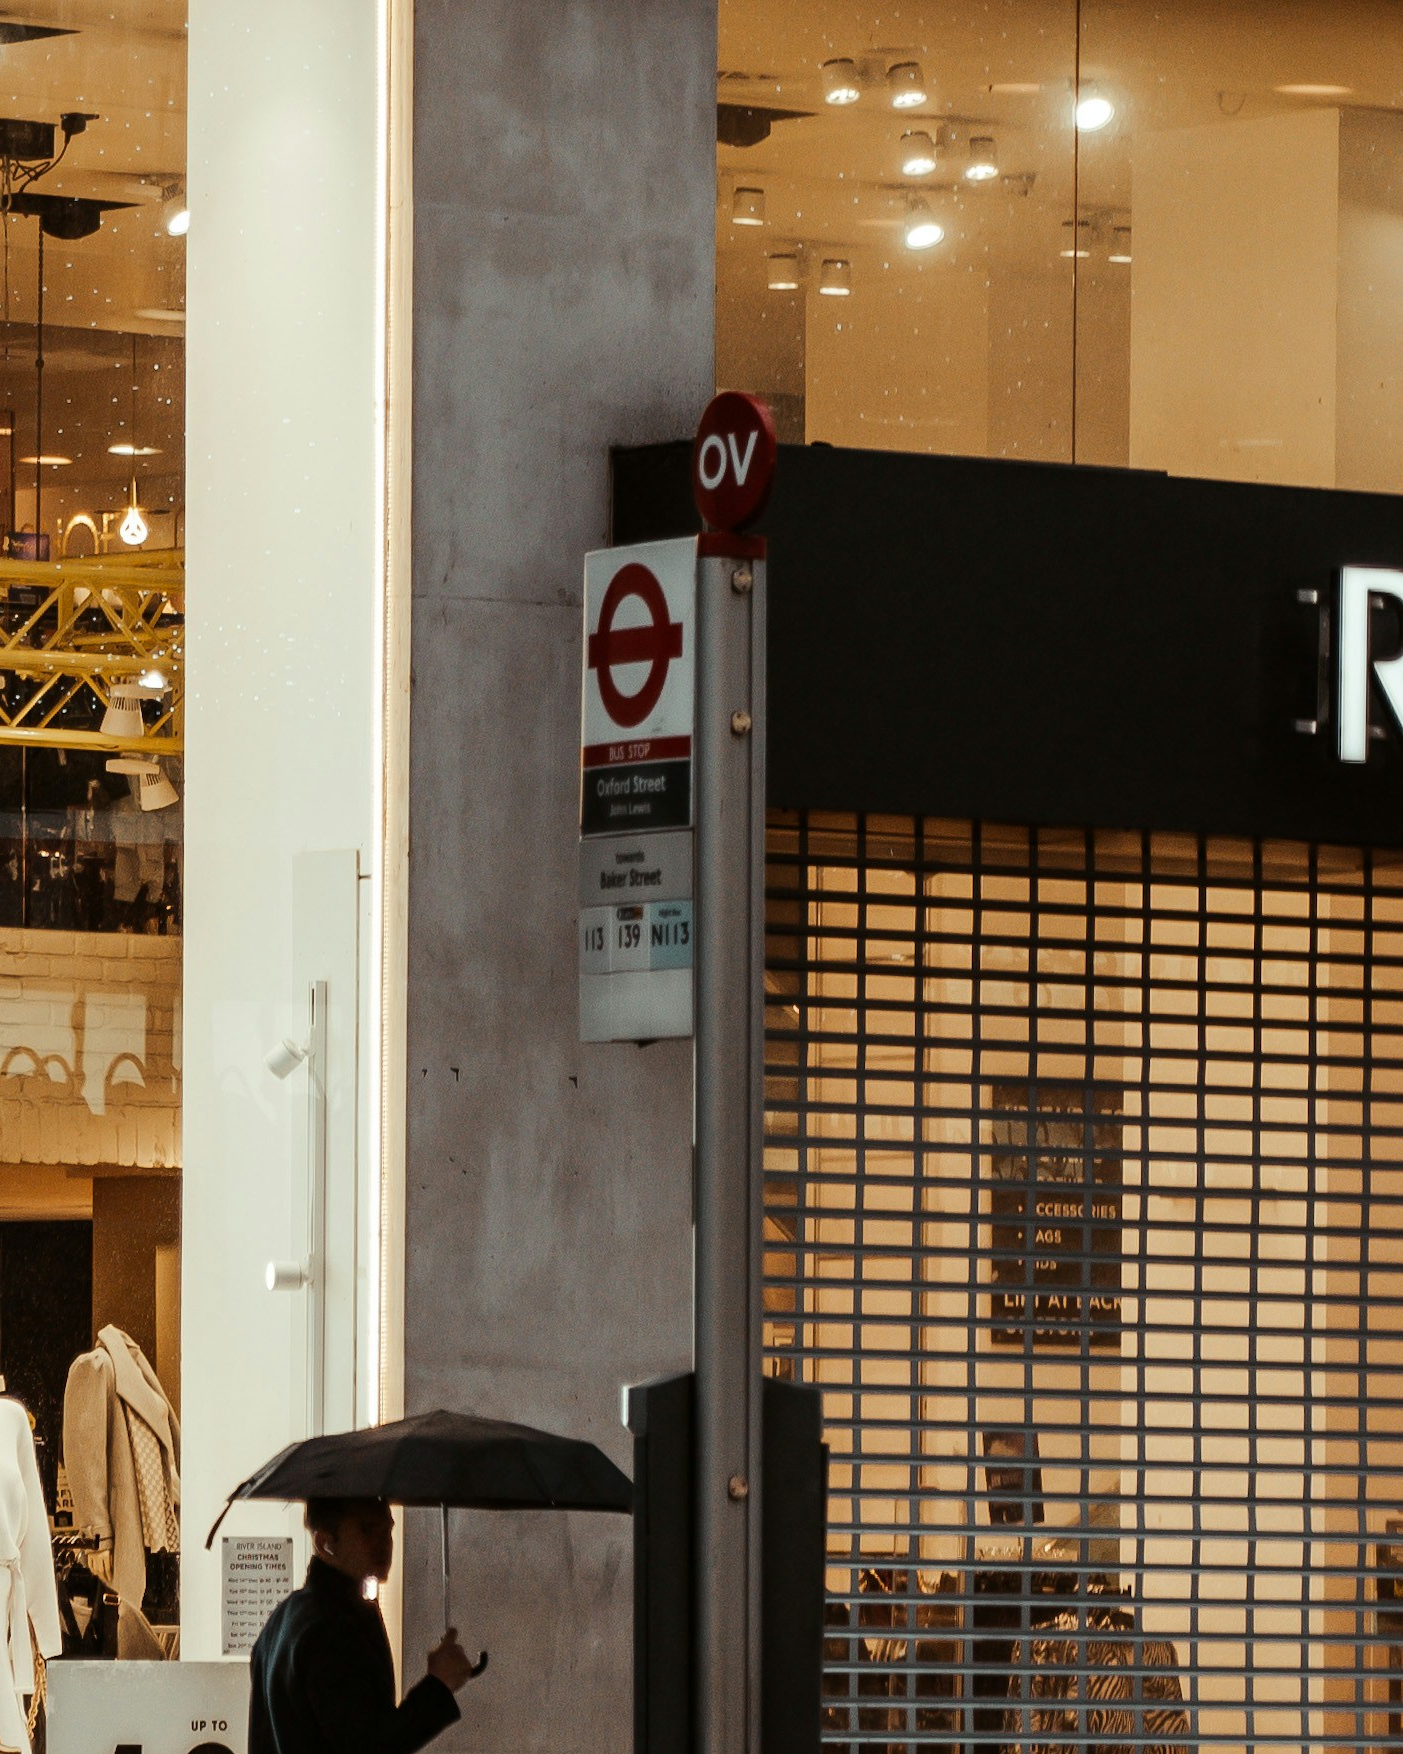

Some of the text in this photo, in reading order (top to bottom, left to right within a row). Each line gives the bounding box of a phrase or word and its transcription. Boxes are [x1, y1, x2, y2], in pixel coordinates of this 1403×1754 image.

[699, 430, 759, 490] OV
[609, 742, 651, 761] BUS STOP
[597, 775, 666, 797] Oxford Street
[600, 867, 662, 890] Baker Street
[584, 921, 689, 952] 113 139 N113
[1035, 1203, 1117, 1219] CCESSRIES
[237, 1553, 279, 1561] CHRISTMAS
[230, 1563, 287, 1571] OPENING TIMES
[191, 1720, 228, 1732] UP TO
